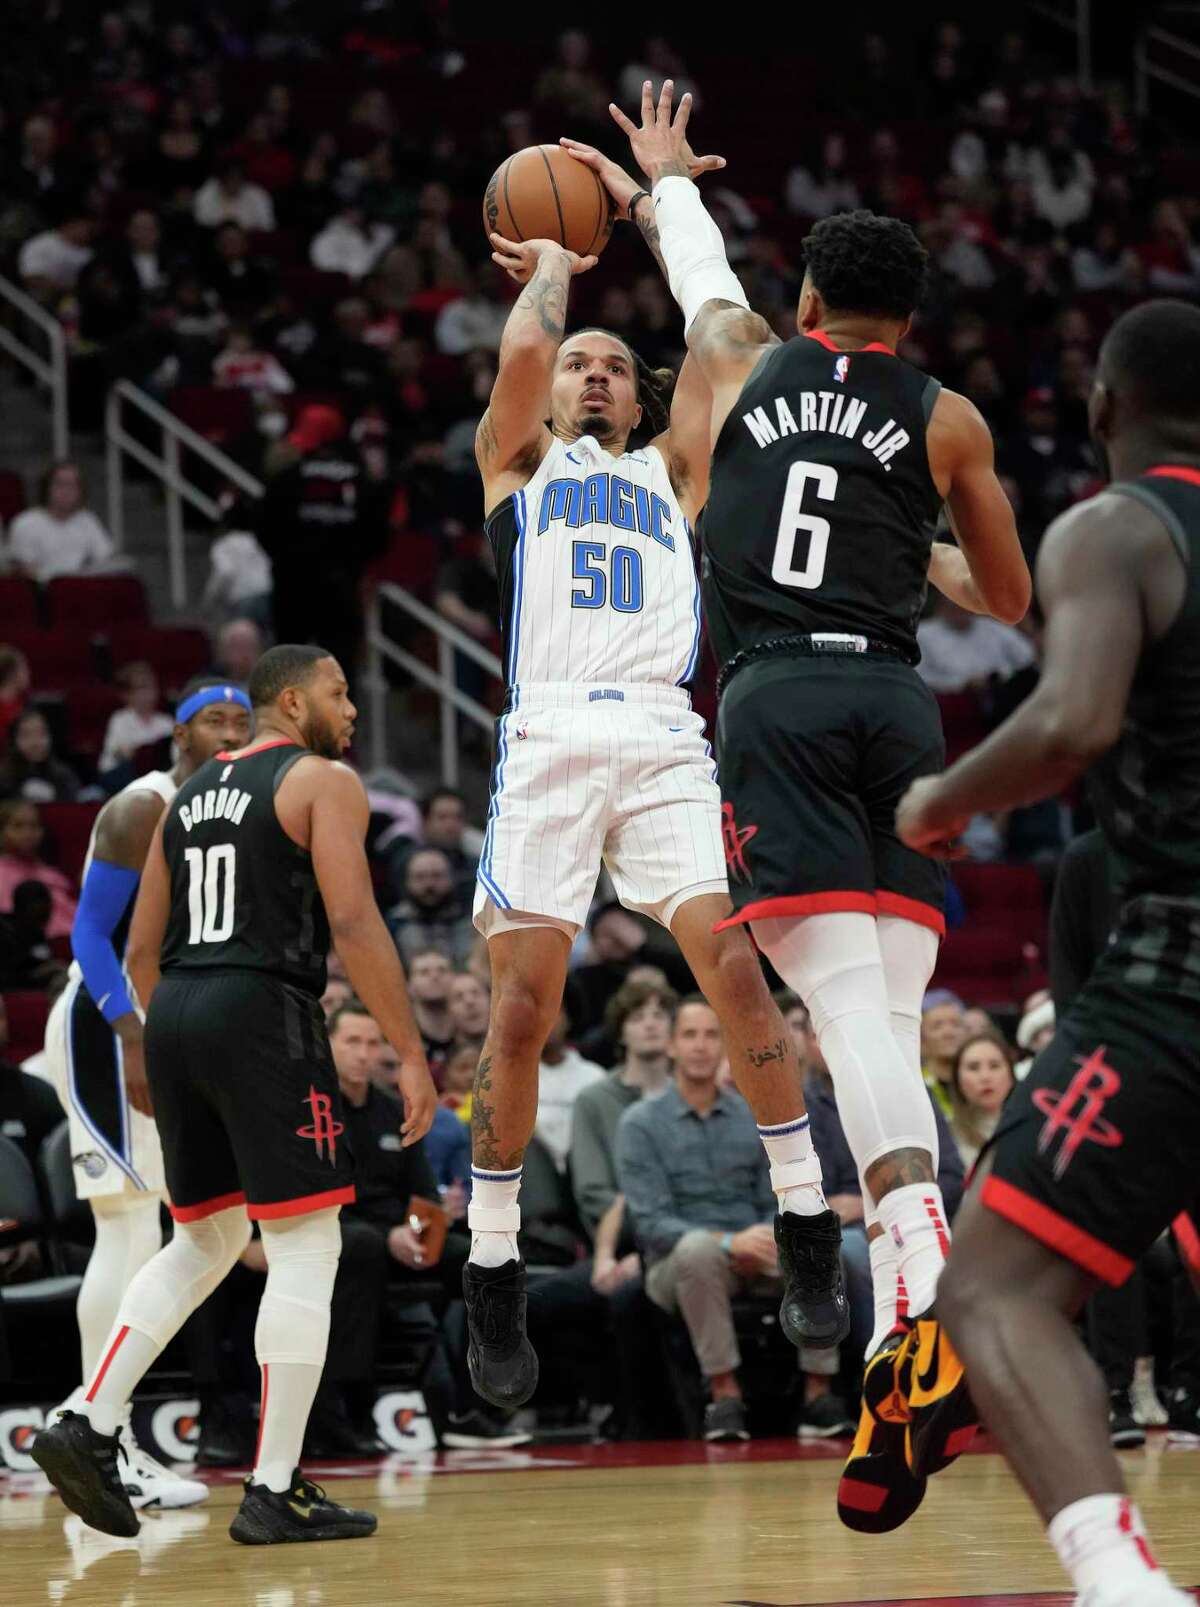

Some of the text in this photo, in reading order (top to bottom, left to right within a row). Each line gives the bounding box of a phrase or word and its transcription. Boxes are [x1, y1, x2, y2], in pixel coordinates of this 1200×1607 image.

[742, 391, 910, 472] MARTIN JR.
[537, 472, 676, 553] MAGIC
[771, 460, 839, 590] 6
[570, 540, 643, 614] 50
[178, 787, 252, 832] GORDON
[184, 843, 236, 945] 10
[372, 1390, 437, 1452] G
